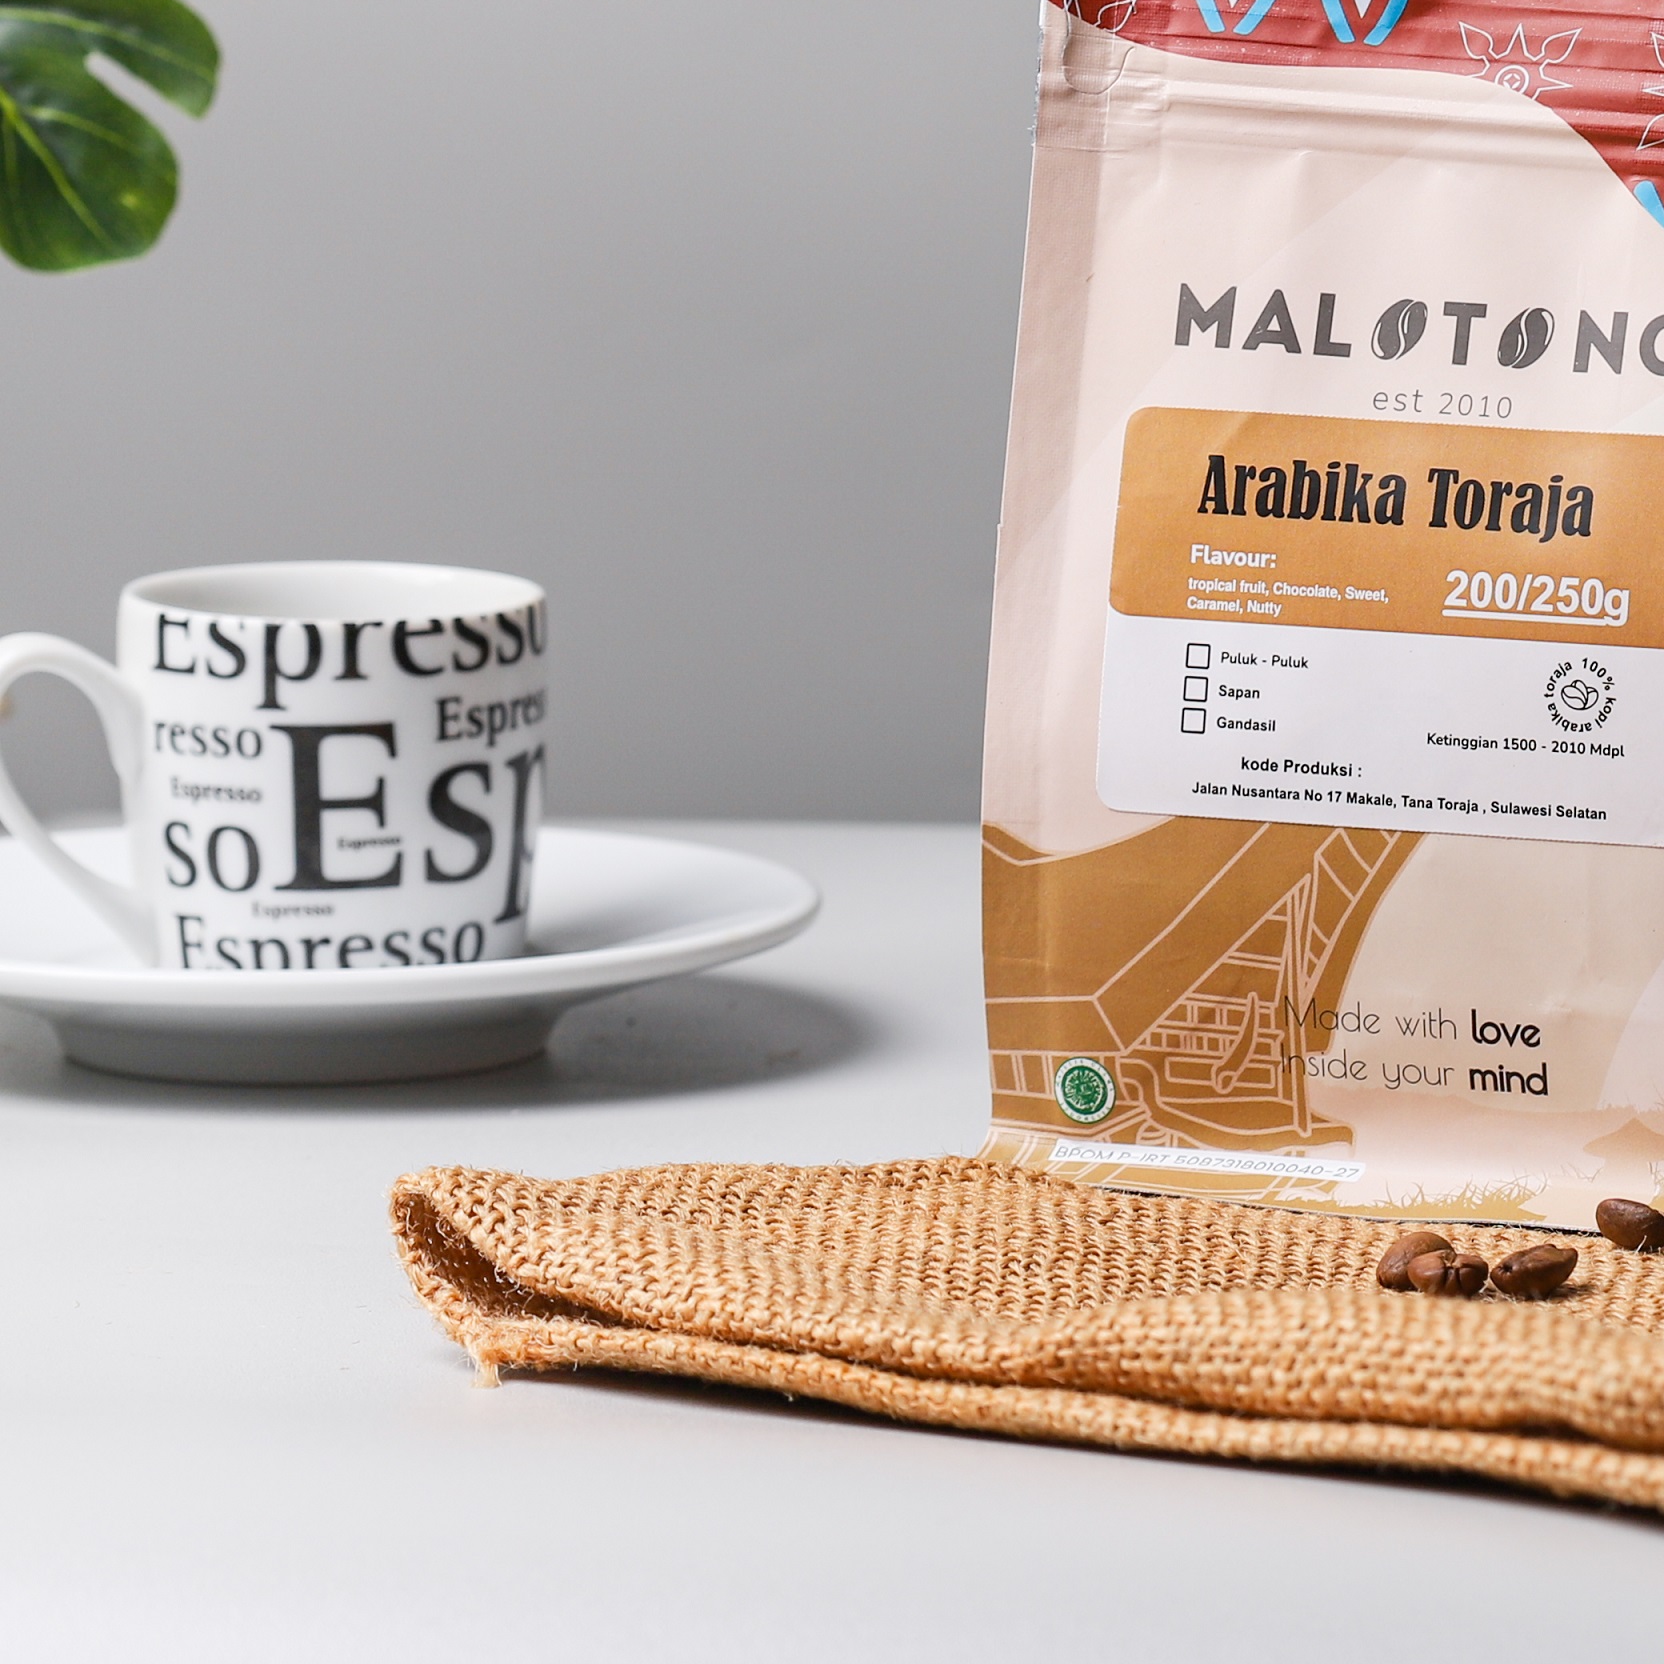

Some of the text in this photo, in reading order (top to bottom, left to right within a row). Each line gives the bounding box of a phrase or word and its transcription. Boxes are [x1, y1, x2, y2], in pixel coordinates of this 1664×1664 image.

[1372, 389, 1513, 419] est 2010
[1197, 454, 1595, 543] Arabika Toraja
[1190, 544, 1277, 569] Flavour:
[1188, 577, 1389, 603] tropical fruit, Chocolate, Sweet,
[1444, 569, 1630, 627] 200/250g
[1187, 596, 1282, 617] Caramel, Nutty
[1220, 652, 1258, 665] Puluk
[1271, 655, 1309, 669] Puluk
[1218, 685, 1260, 700] Sapan
[1544, 657, 1616, 732] 100% kopi arabika toraja
[1217, 716, 1276, 732] Gandasil
[1427, 733, 1498, 750] Ketinggian
[1503, 738, 1537, 751] 1500
[1551, 741, 1586, 755] 2010
[1590, 744, 1625, 759] Mdpl
[1241, 757, 1279, 772] kode
[1284, 759, 1352, 777] Produksi
[170, 776, 262, 803] Espresso
[1192, 782, 1227, 796] Jalan
[1232, 784, 1300, 801] Nusantara
[1304, 789, 1323, 802] No
[1327, 791, 1342, 803] 17
[1346, 792, 1397, 808] Makale,
[1401, 795, 1433, 809] Tana
[1437, 797, 1479, 814] Toraja
[1491, 801, 1551, 817] Sulawesi
[1556, 806, 1607, 820] Selatan
[337, 835, 402, 850] Espresso
[252, 901, 334, 919] Espresso
[1284, 995, 1541, 1048] Made with love
[1280, 1042, 1548, 1096] Inside your mind
[1055, 1146, 1113, 1160] BPOM
[1117, 1151, 1171, 1163] P-IRT
